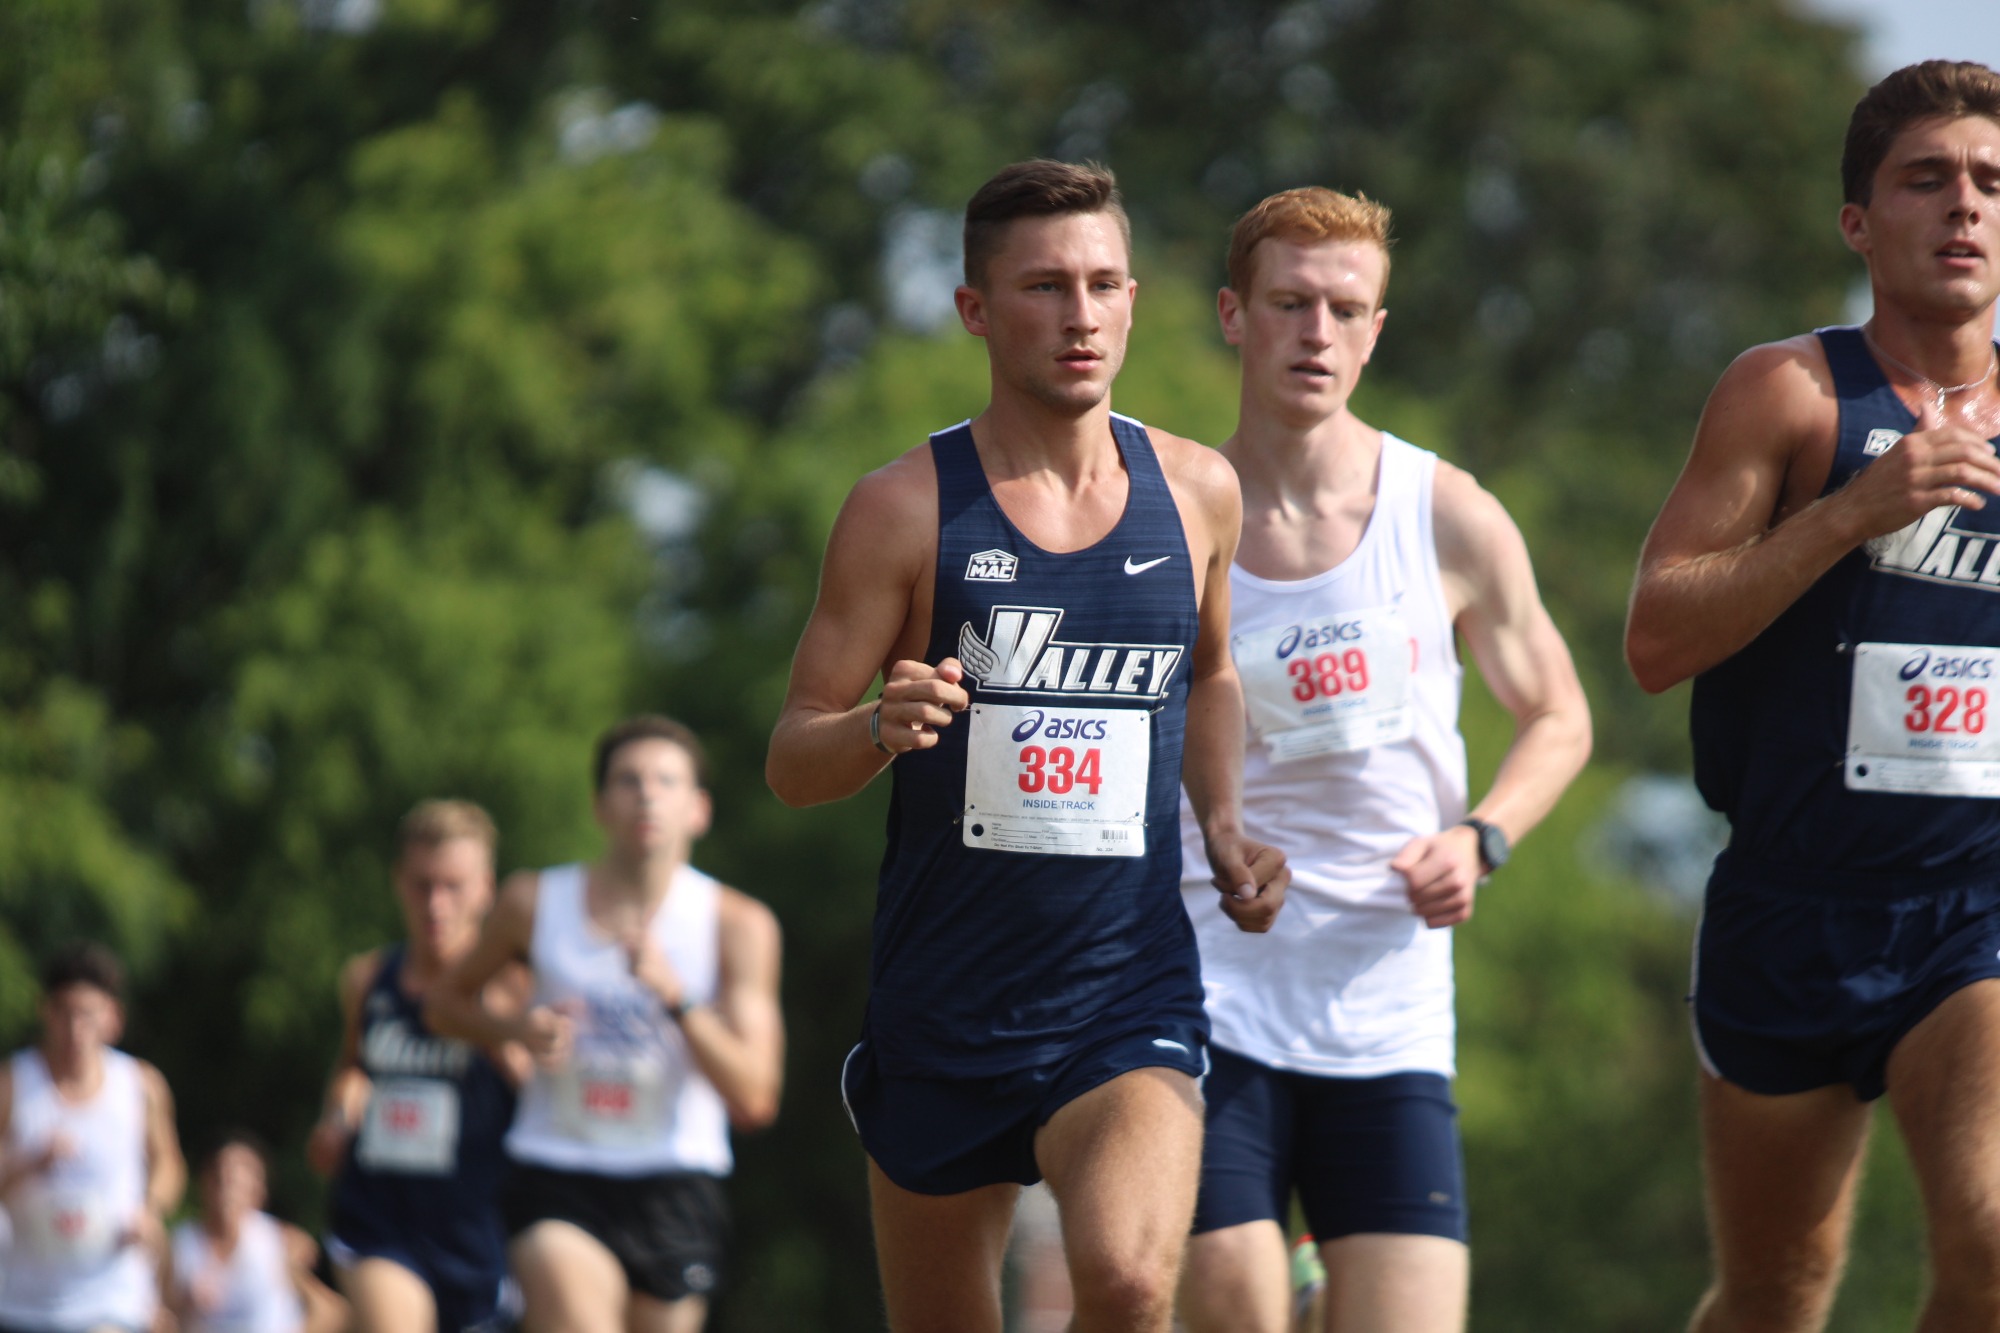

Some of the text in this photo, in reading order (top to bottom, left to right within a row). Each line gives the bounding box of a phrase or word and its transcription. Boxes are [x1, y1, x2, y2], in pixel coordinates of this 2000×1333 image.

[969, 564, 1013, 579] MAC
[980, 609, 1181, 696] VALLEY
[1931, 657, 1993, 678] asics
[1287, 647, 1370, 703] 389
[1904, 684, 1986, 734] 328
[1044, 717, 1107, 740] asics
[1018, 745, 1102, 795] 334
[1022, 799, 1095, 810] INSIDE TRACK
